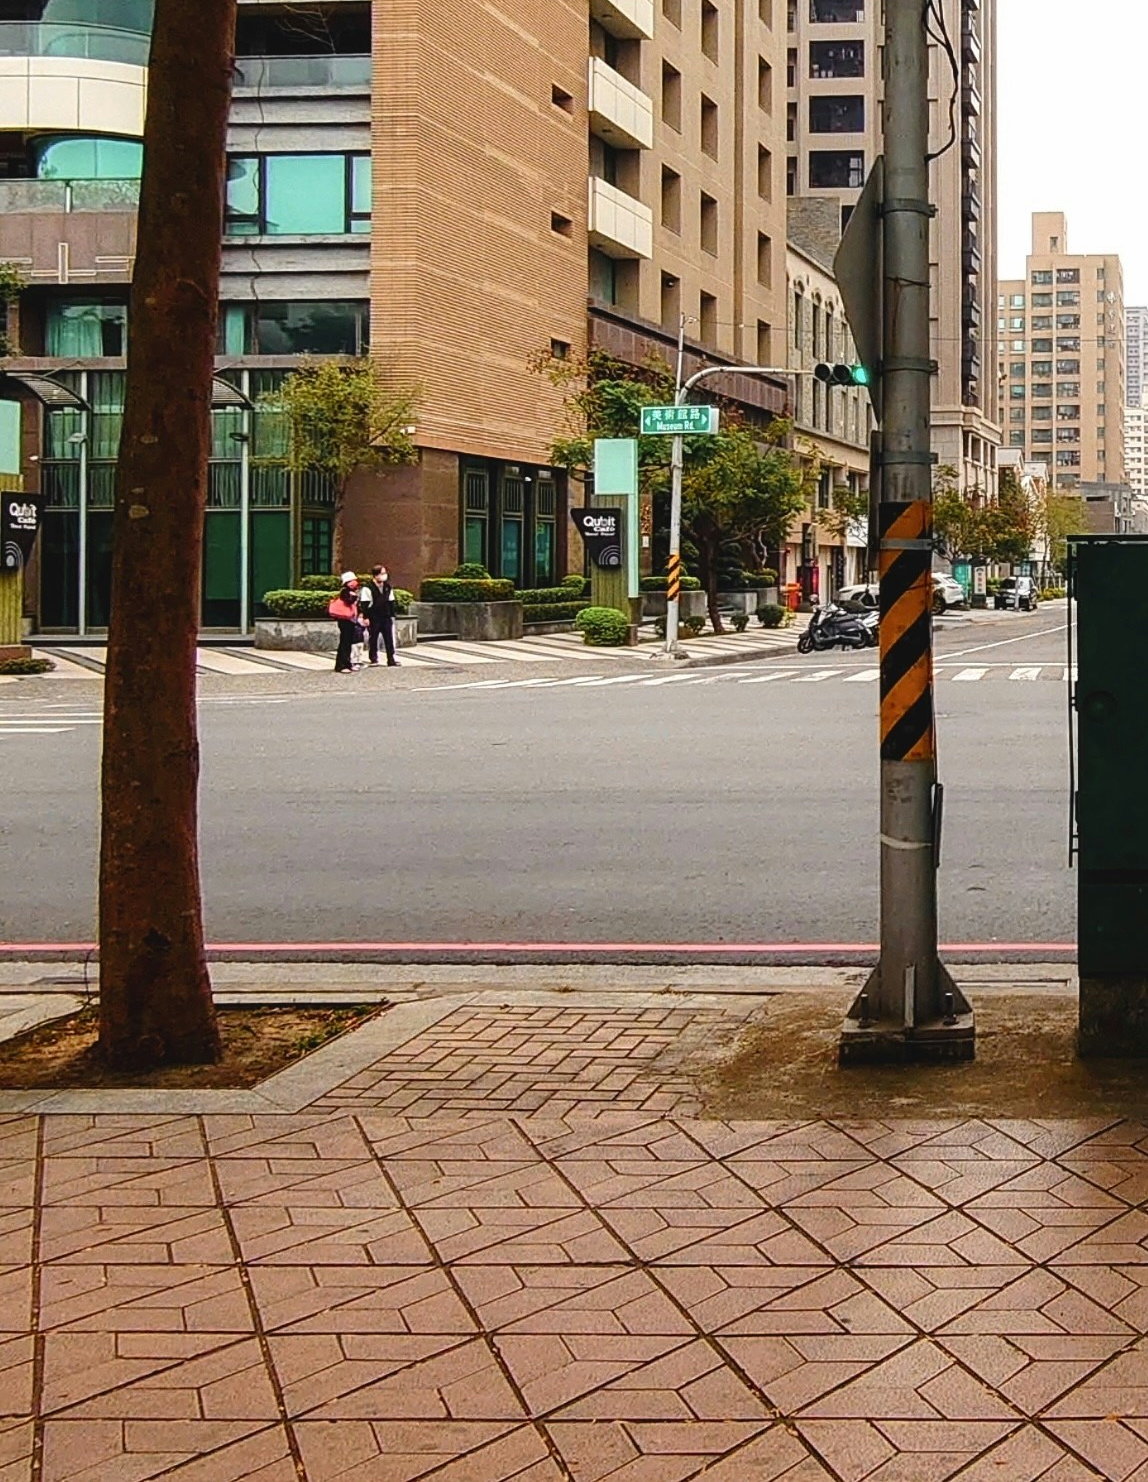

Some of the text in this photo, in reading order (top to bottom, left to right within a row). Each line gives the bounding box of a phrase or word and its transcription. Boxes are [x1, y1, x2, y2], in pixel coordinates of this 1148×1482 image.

[651, 408, 700, 421] 美術館路
[656, 421, 683, 431] Museum
[9, 502, 37, 517] Qubit
[583, 515, 616, 527] Qubit
